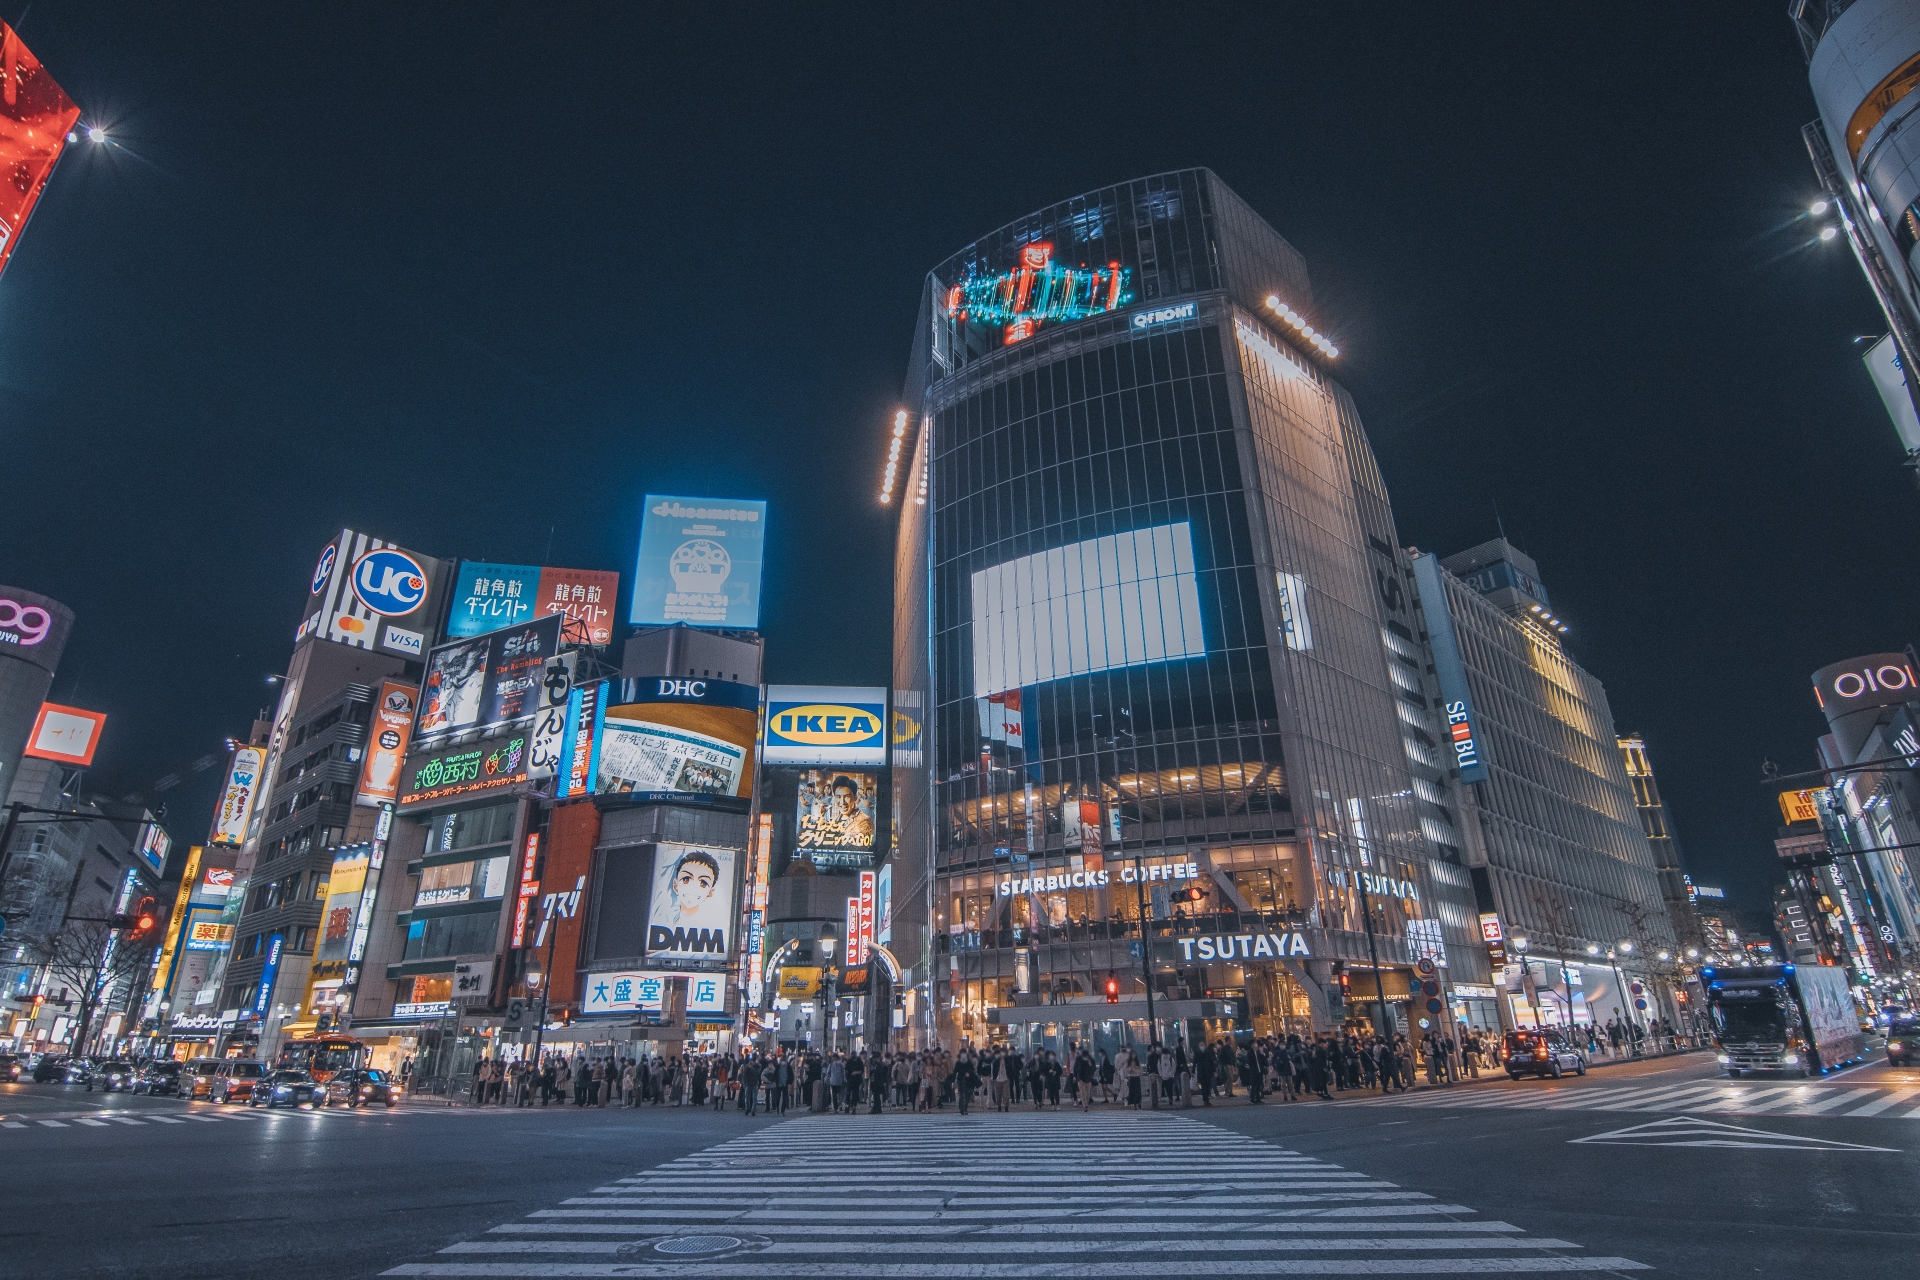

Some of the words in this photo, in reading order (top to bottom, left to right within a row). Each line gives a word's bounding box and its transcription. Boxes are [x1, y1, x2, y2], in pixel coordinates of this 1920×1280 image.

[1134, 305, 1194, 329] QFRONT
[360, 561, 424, 603] UC
[474, 577, 523, 599] 龍角散
[554, 583, 603, 604] 龍角散
[390, 632, 421, 650] VISA
[658, 679, 707, 698] DHC
[531, 657, 571, 774] もんじゃ
[780, 715, 876, 734] IKEA
[570, 688, 596, 789] 三千里薬品
[1446, 700, 1478, 769] SEIBU
[443, 759, 481, 785] 西村
[649, 793, 665, 801] DHC
[666, 793, 695, 801] Channel
[1000, 868, 1109, 897] STARBUCKS
[1120, 862, 1200, 883] COFFEE
[862, 879, 872, 930] カラオケ
[197, 923, 217, 940] 薬
[649, 924, 725, 954] DMM
[1179, 933, 1311, 962] TSUTAYA
[593, 980, 715, 1004] 大盛堂店
